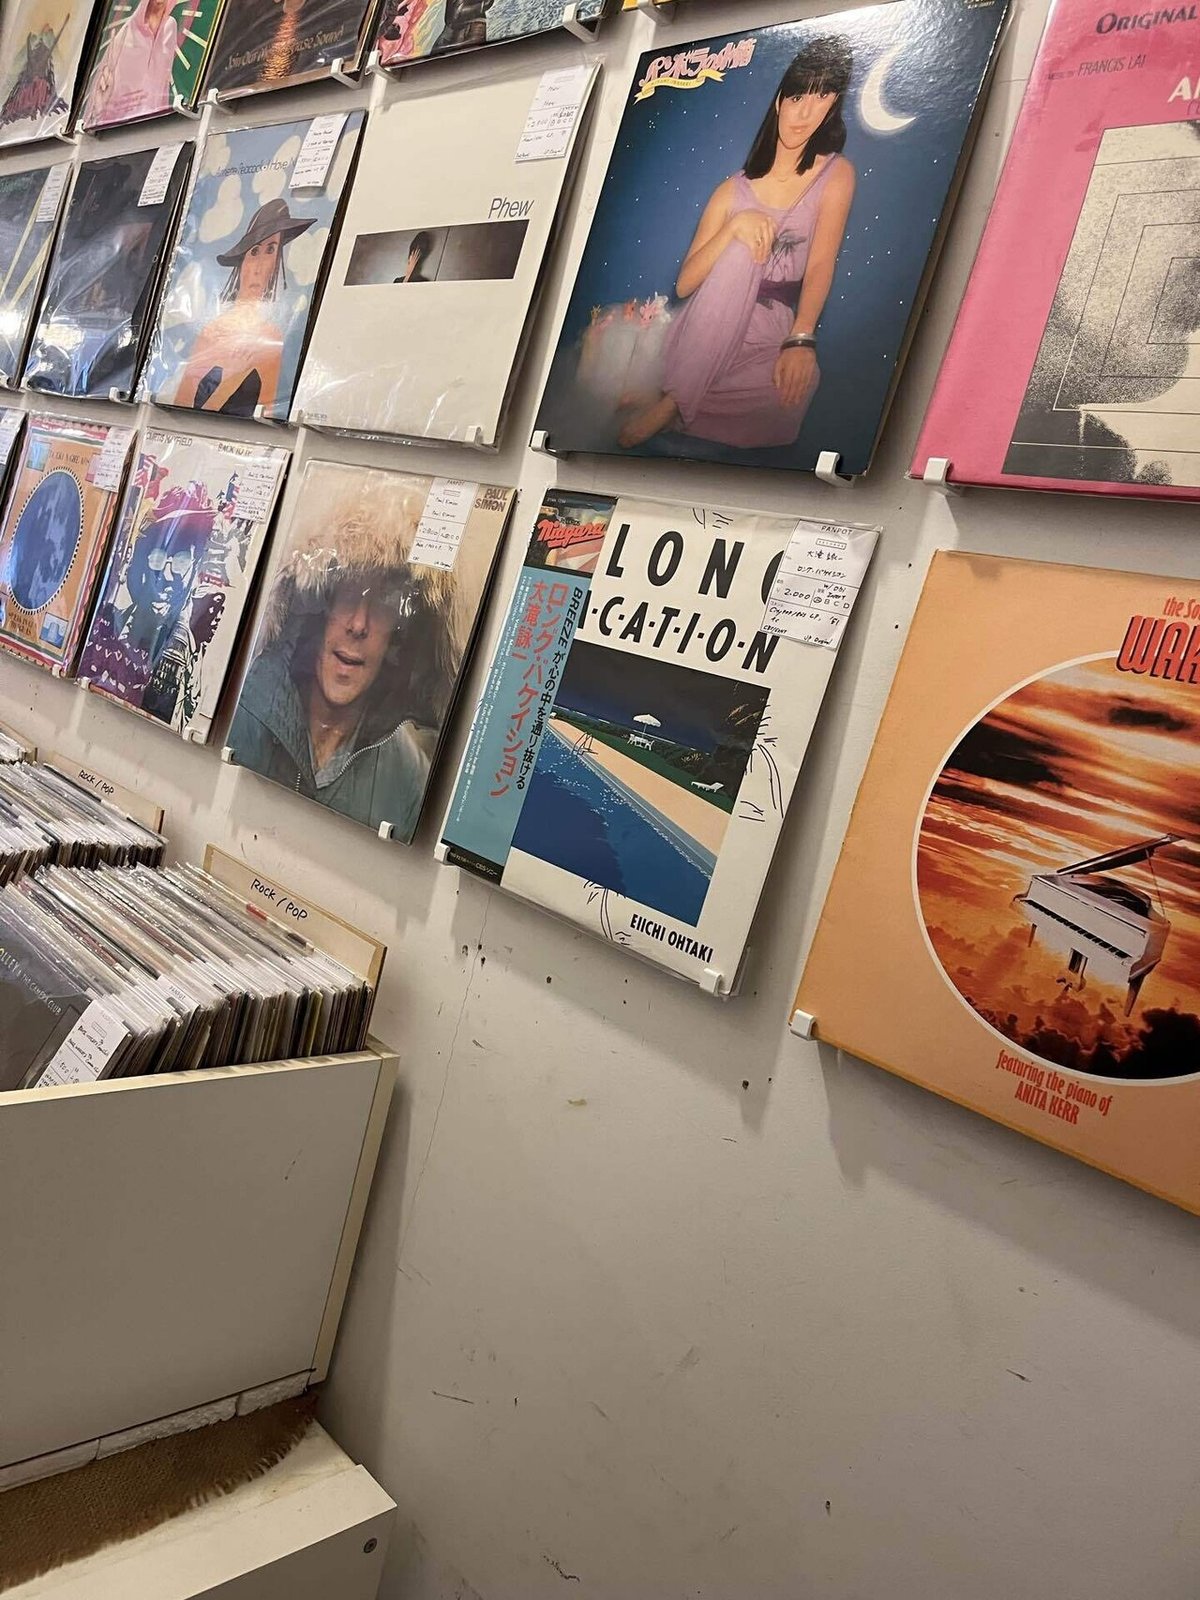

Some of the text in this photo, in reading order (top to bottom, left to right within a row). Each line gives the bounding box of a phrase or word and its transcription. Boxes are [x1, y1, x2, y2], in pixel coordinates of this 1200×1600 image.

[1077, 57, 1126, 77] FRANCIS
[1167, 76, 1200, 103] A
[488, 197, 535, 219] Phew
[474, 498, 507, 513] SIMON
[484, 488, 509, 501] PAUL
[537, 518, 607, 549] Niagara
[821, 525, 853, 536] PANPOT
[558, 586, 584, 649] BREEZE
[1163, 597, 1200, 620] the So
[630, 913, 714, 963] EIICHI OHTAKI
[47, 1000, 62, 1016] CLUB
[995, 1049, 1114, 1117] featuring the piano of
[1014, 1080, 1081, 1125] ANITA KERR
